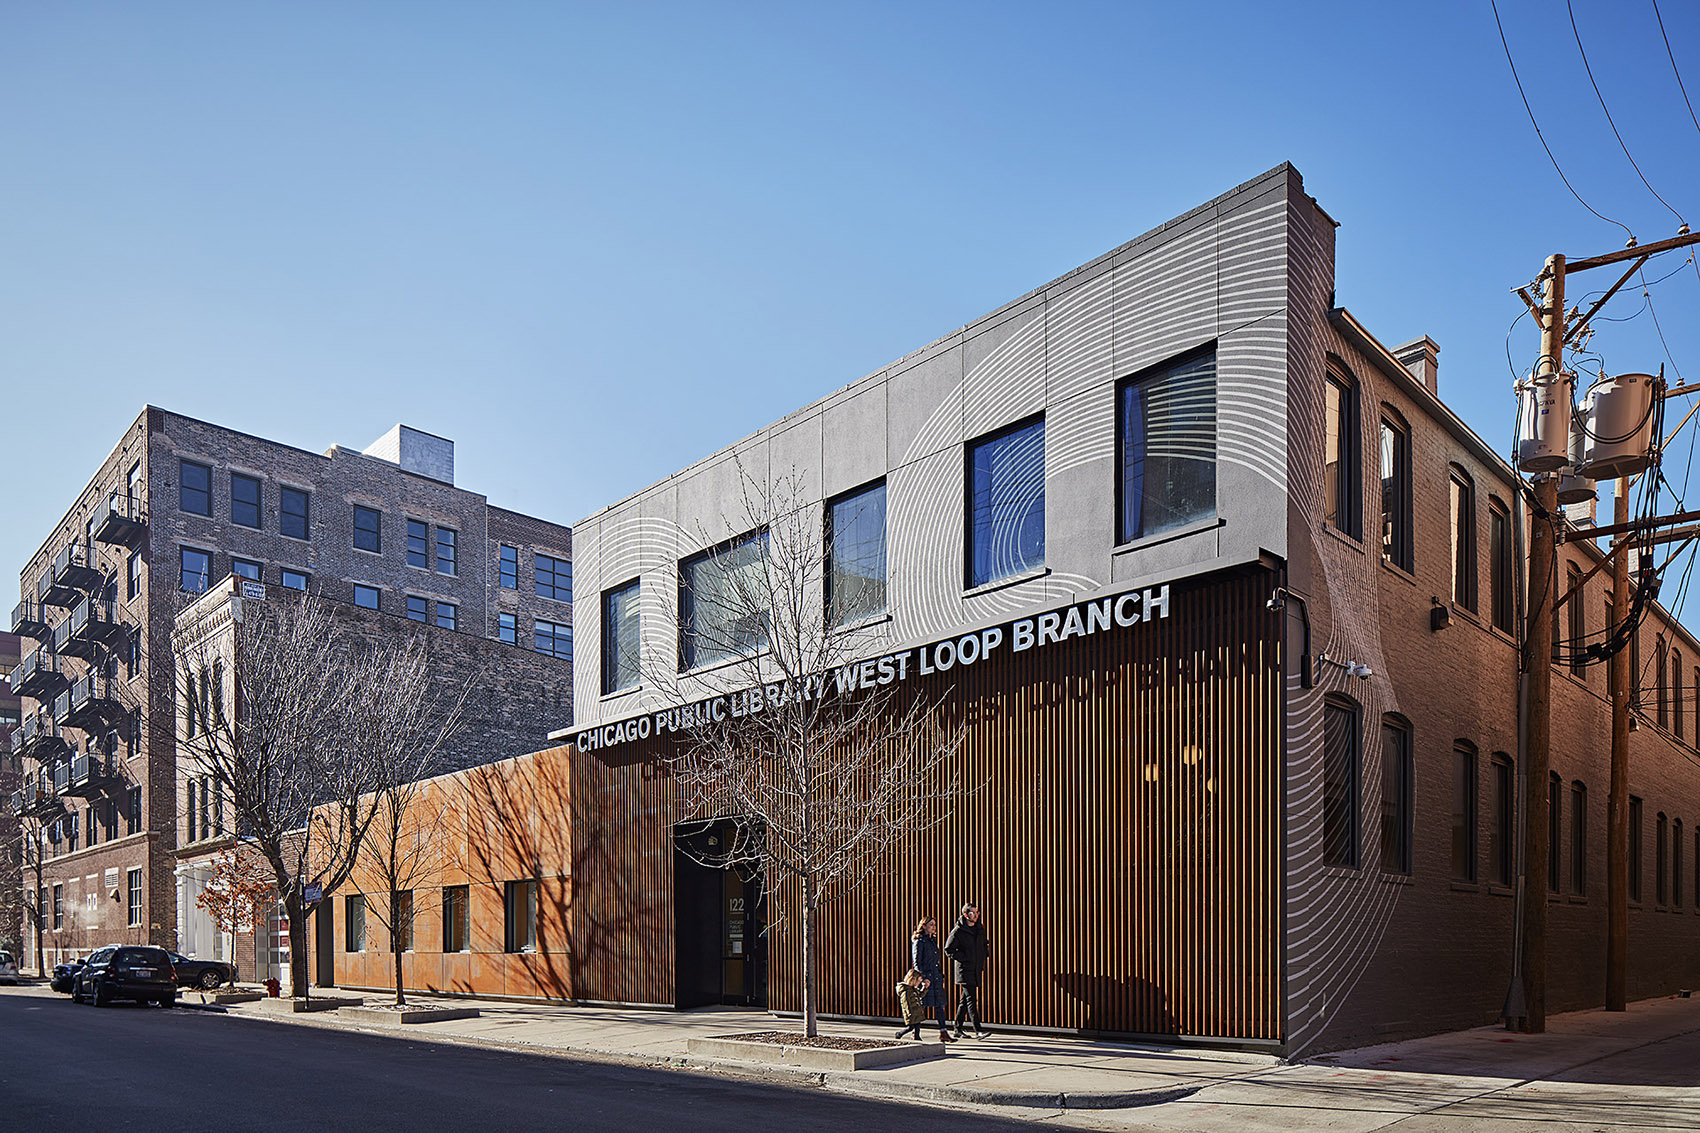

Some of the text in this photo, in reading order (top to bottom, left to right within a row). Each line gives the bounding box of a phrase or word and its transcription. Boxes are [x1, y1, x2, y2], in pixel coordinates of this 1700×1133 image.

[577, 716, 651, 753] CHICAGO
[655, 697, 726, 736] PUBLIC
[835, 651, 911, 696] WEST
[919, 627, 1003, 676] LOOP
[1013, 584, 1169, 653] BRANCH
[729, 898, 744, 911] 122
